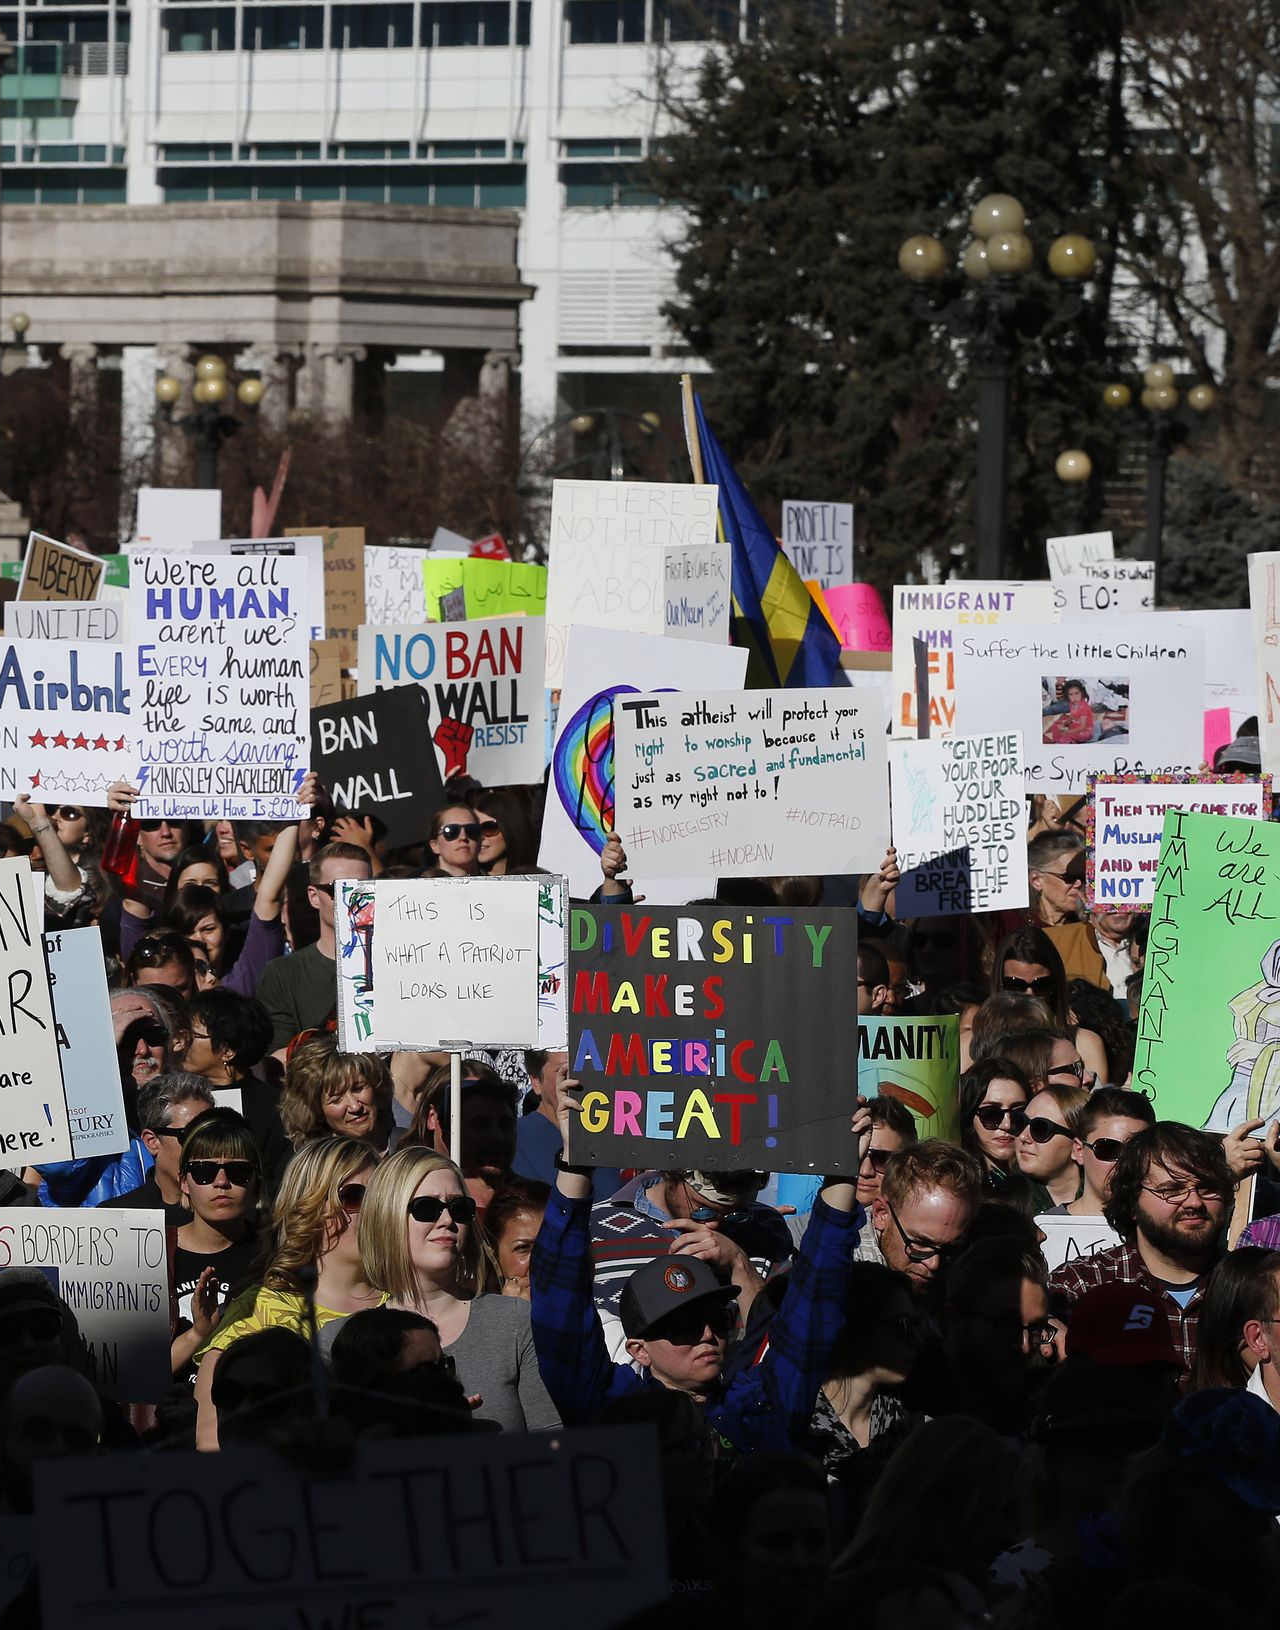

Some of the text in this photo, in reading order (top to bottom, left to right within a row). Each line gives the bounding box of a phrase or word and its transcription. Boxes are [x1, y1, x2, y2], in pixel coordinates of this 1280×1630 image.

[27, 540, 102, 601] LIBERTY
[238, 556, 279, 587] all
[825, 546, 845, 575] IS
[146, 587, 298, 620] HUMAN,
[900, 590, 1015, 611] IMMIGRANT
[16, 608, 119, 640] UNITED
[158, 618, 296, 645] aren't we?
[375, 626, 523, 681] NO BAN
[962, 637, 1187, 661] Suffer the little Children
[434, 679, 529, 727] WALL
[621, 697, 859, 731] This atheist will protect your
[318, 710, 378, 756] BAN
[475, 725, 528, 748] RESIST
[634, 728, 817, 767] right to worship because
[996, 734, 1018, 755] ME
[150, 766, 293, 796] KINGSLEY SHACKLEBOLT
[941, 760, 981, 782] YOUR
[785, 807, 862, 831] #NOTPAID
[943, 800, 1020, 826] HUDDLED
[1100, 796, 1144, 818] THEN
[627, 810, 730, 850] #NOREGISTRY
[943, 823, 1017, 849] MASSES
[1216, 825, 1271, 858] We
[708, 842, 775, 867] #NOBAN
[914, 866, 1010, 894] BREATHE
[1100, 877, 1143, 898] NOT
[1218, 862, 1267, 886] are
[388, 894, 486, 921] THIS IS
[1203, 887, 1278, 926] ALL
[384, 941, 532, 966] WHAT A PATRIOT
[399, 979, 494, 1001] LOOKS LIKE
[571, 969, 726, 1019] MAKES
[20, 1224, 119, 1269] BORDERS
[130, 1227, 164, 1270] TO
[61, 1280, 163, 1313] IMMIGRANTS
[64, 1452, 632, 1590] TOGETHER
